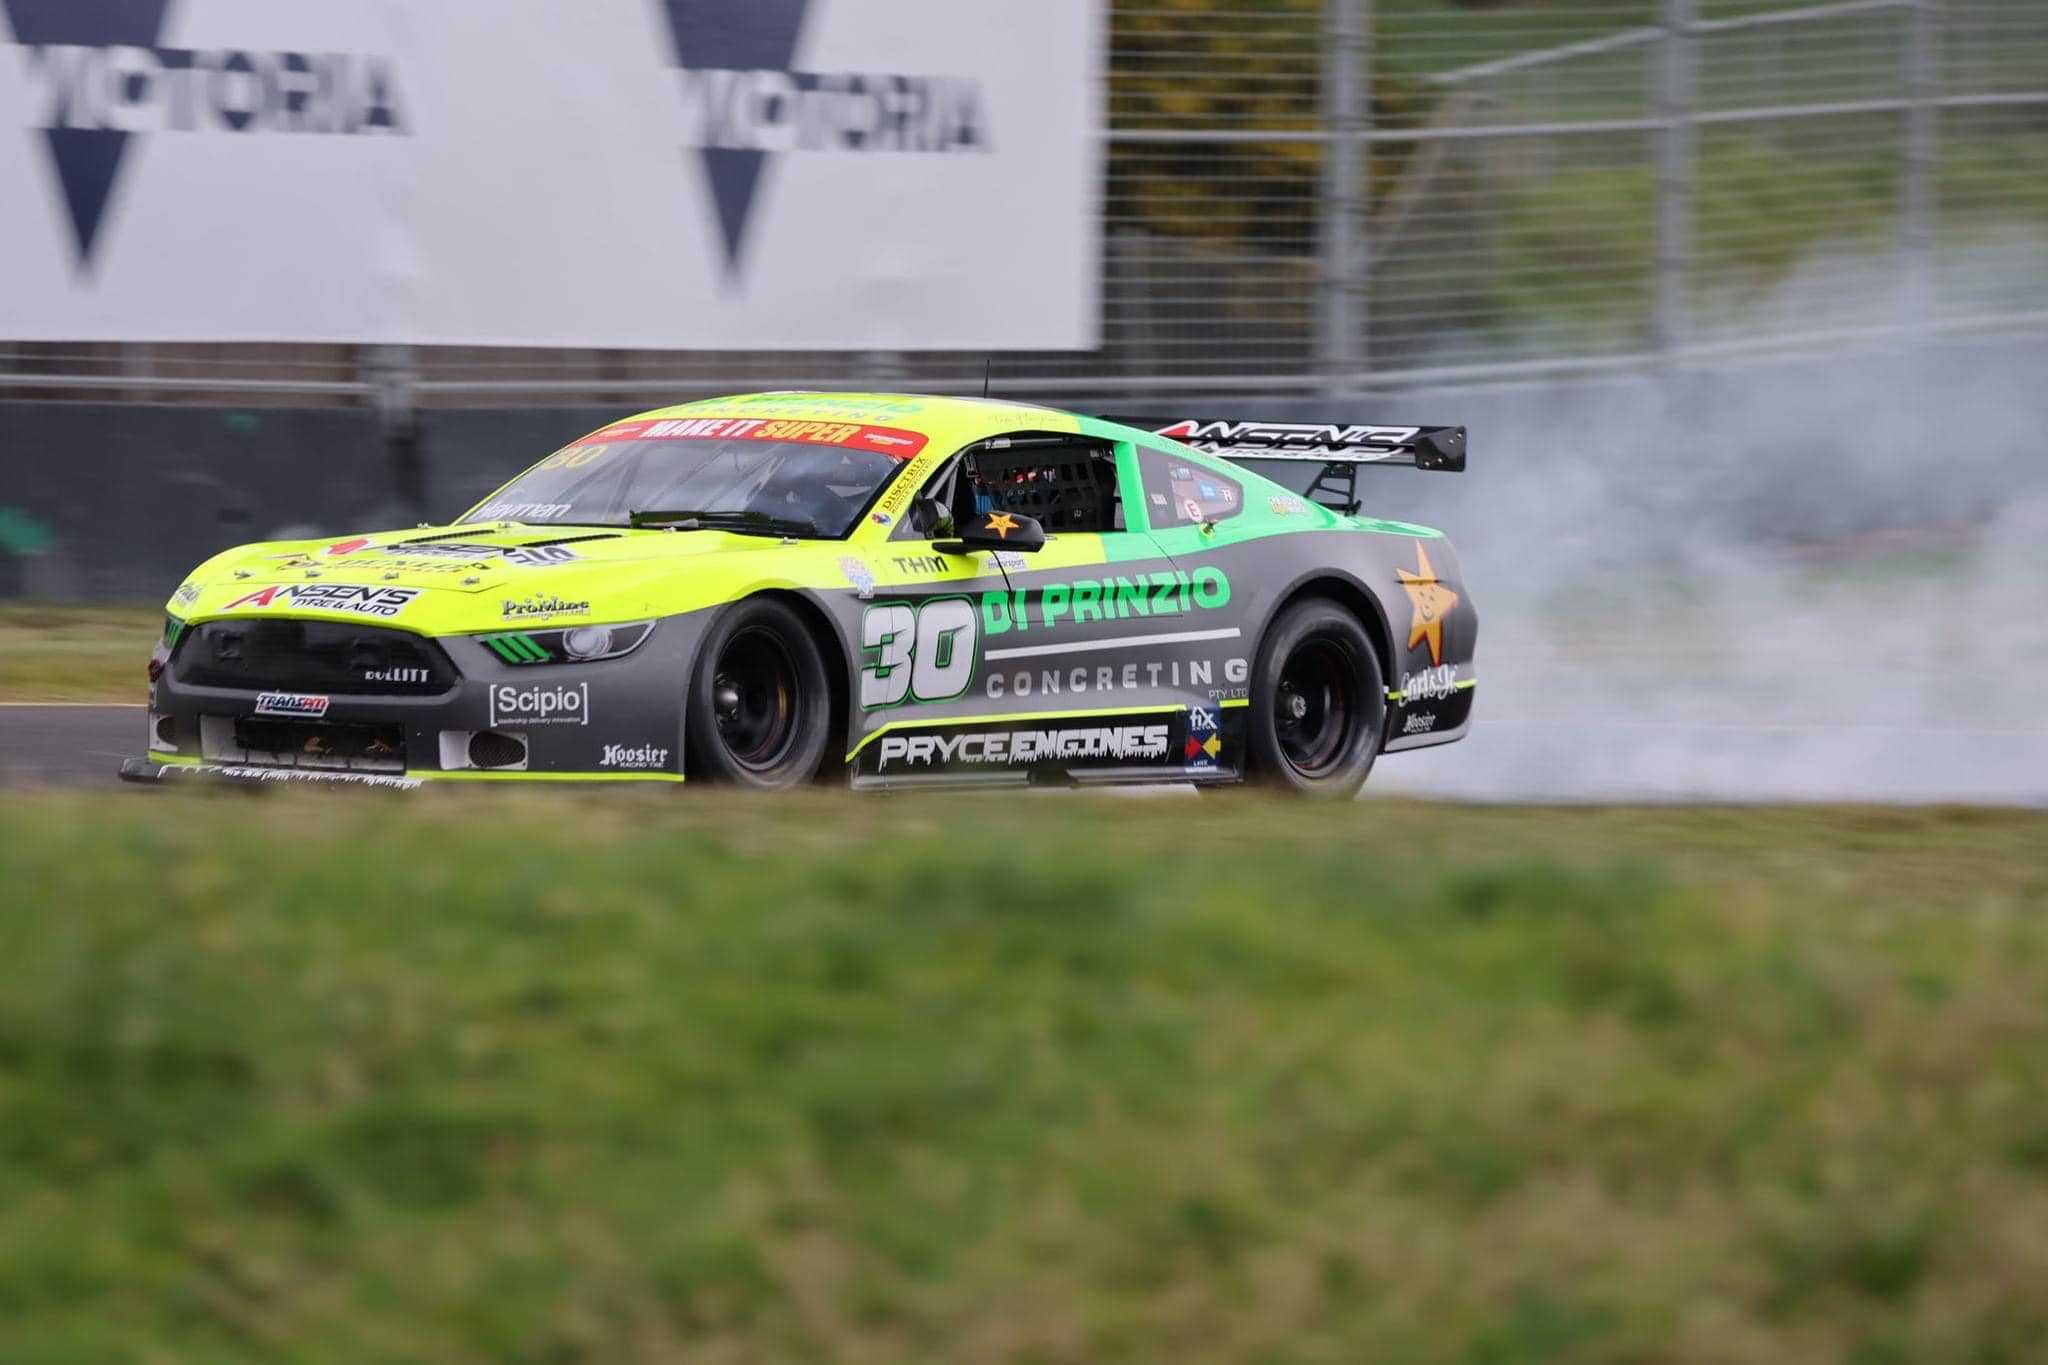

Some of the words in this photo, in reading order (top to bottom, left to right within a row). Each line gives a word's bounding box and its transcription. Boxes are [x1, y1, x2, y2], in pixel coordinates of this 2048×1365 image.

[640, 419, 729, 437] MAKE
[725, 420, 765, 437] IT
[753, 420, 863, 443] SUPER
[224, 585, 419, 609] ANSEN'S
[346, 602, 398, 616] AUTO
[981, 588, 1029, 635] DI
[1038, 566, 1231, 628] PRINZIO
[860, 595, 979, 711] 30
[986, 658, 1248, 698] CONCRETING
[1209, 690, 1227, 698] PTY
[1231, 689, 1248, 698] LTD
[1190, 706, 1217, 729] fix
[600, 744, 668, 766] Hoosier
[879, 734, 1008, 772] PRYCE
[1009, 725, 1168, 764] ENGINES
